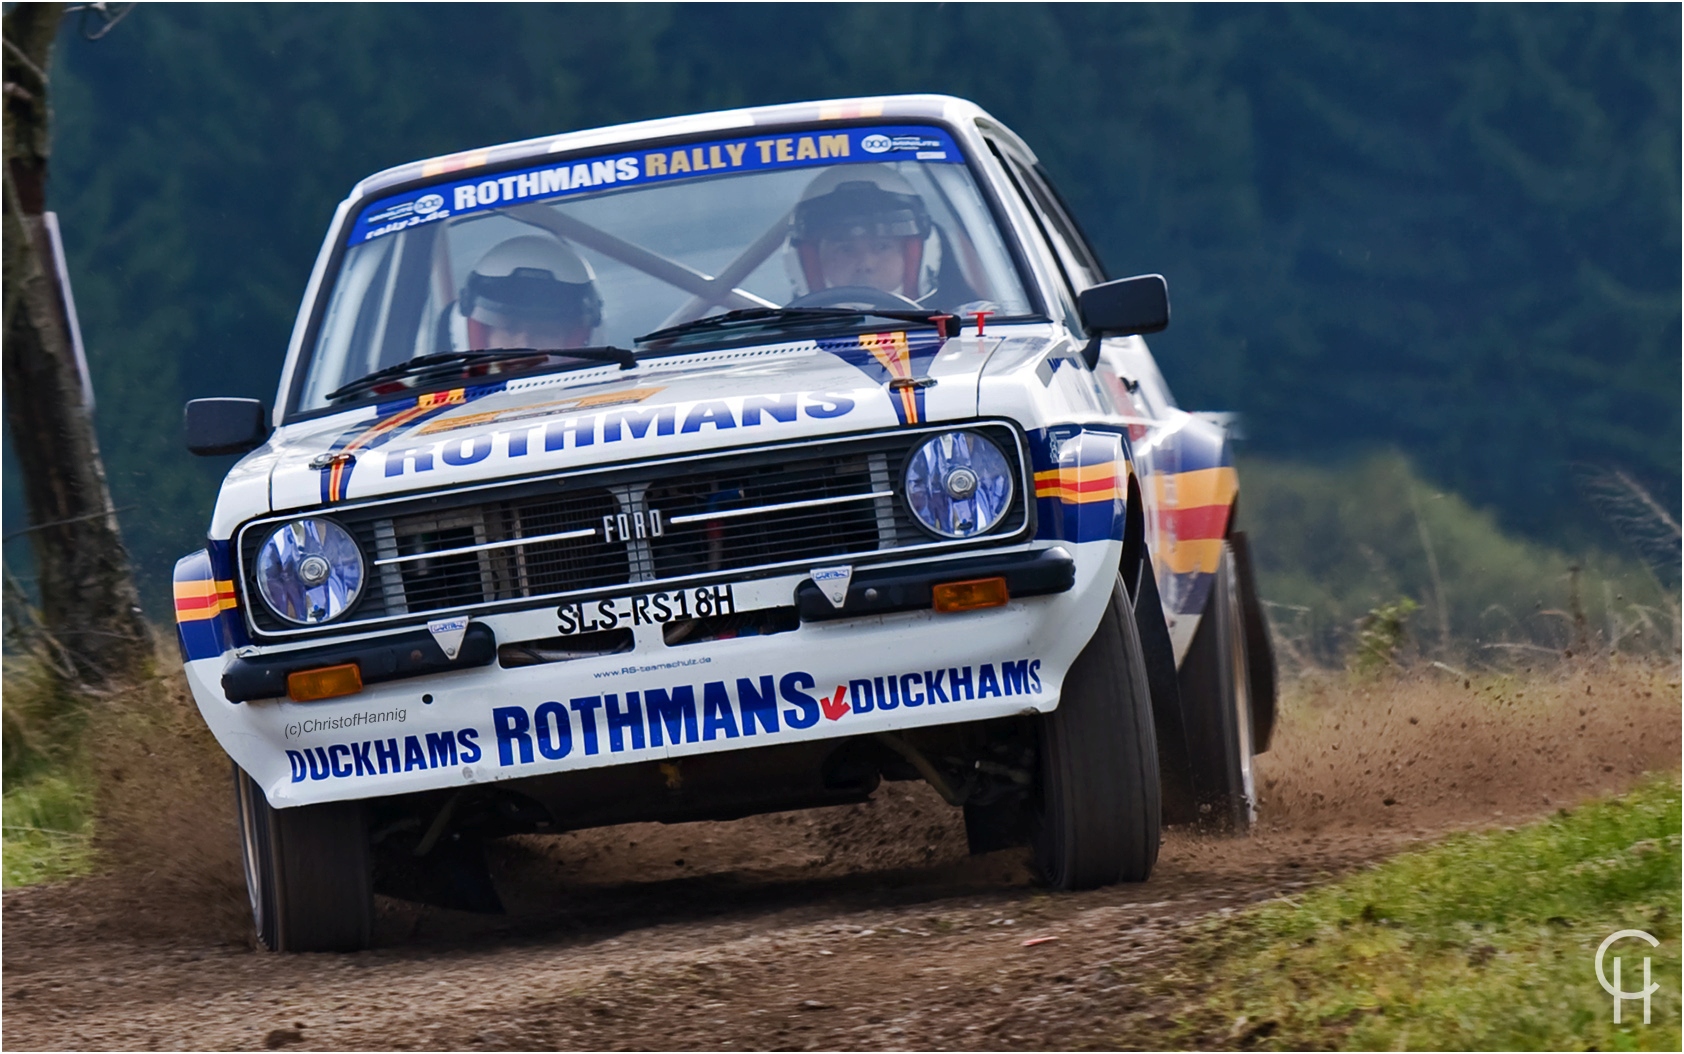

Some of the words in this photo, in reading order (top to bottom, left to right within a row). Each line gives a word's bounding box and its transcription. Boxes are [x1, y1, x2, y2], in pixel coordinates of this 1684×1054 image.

[453, 156, 640, 211] ROTHMANS
[644, 142, 747, 177] RALLY
[755, 133, 851, 164] TEAM
[383, 386, 857, 478] ROTHMANS
[603, 508, 665, 544] FORD
[557, 584, 736, 635] SLS-RS18H
[593, 656, 712, 679] www.RS-teamschulz.de
[492, 671, 821, 768] ROTHMANS
[848, 658, 1042, 715] DUCKHAMS
[284, 726, 483, 785] DUCKHAMS
